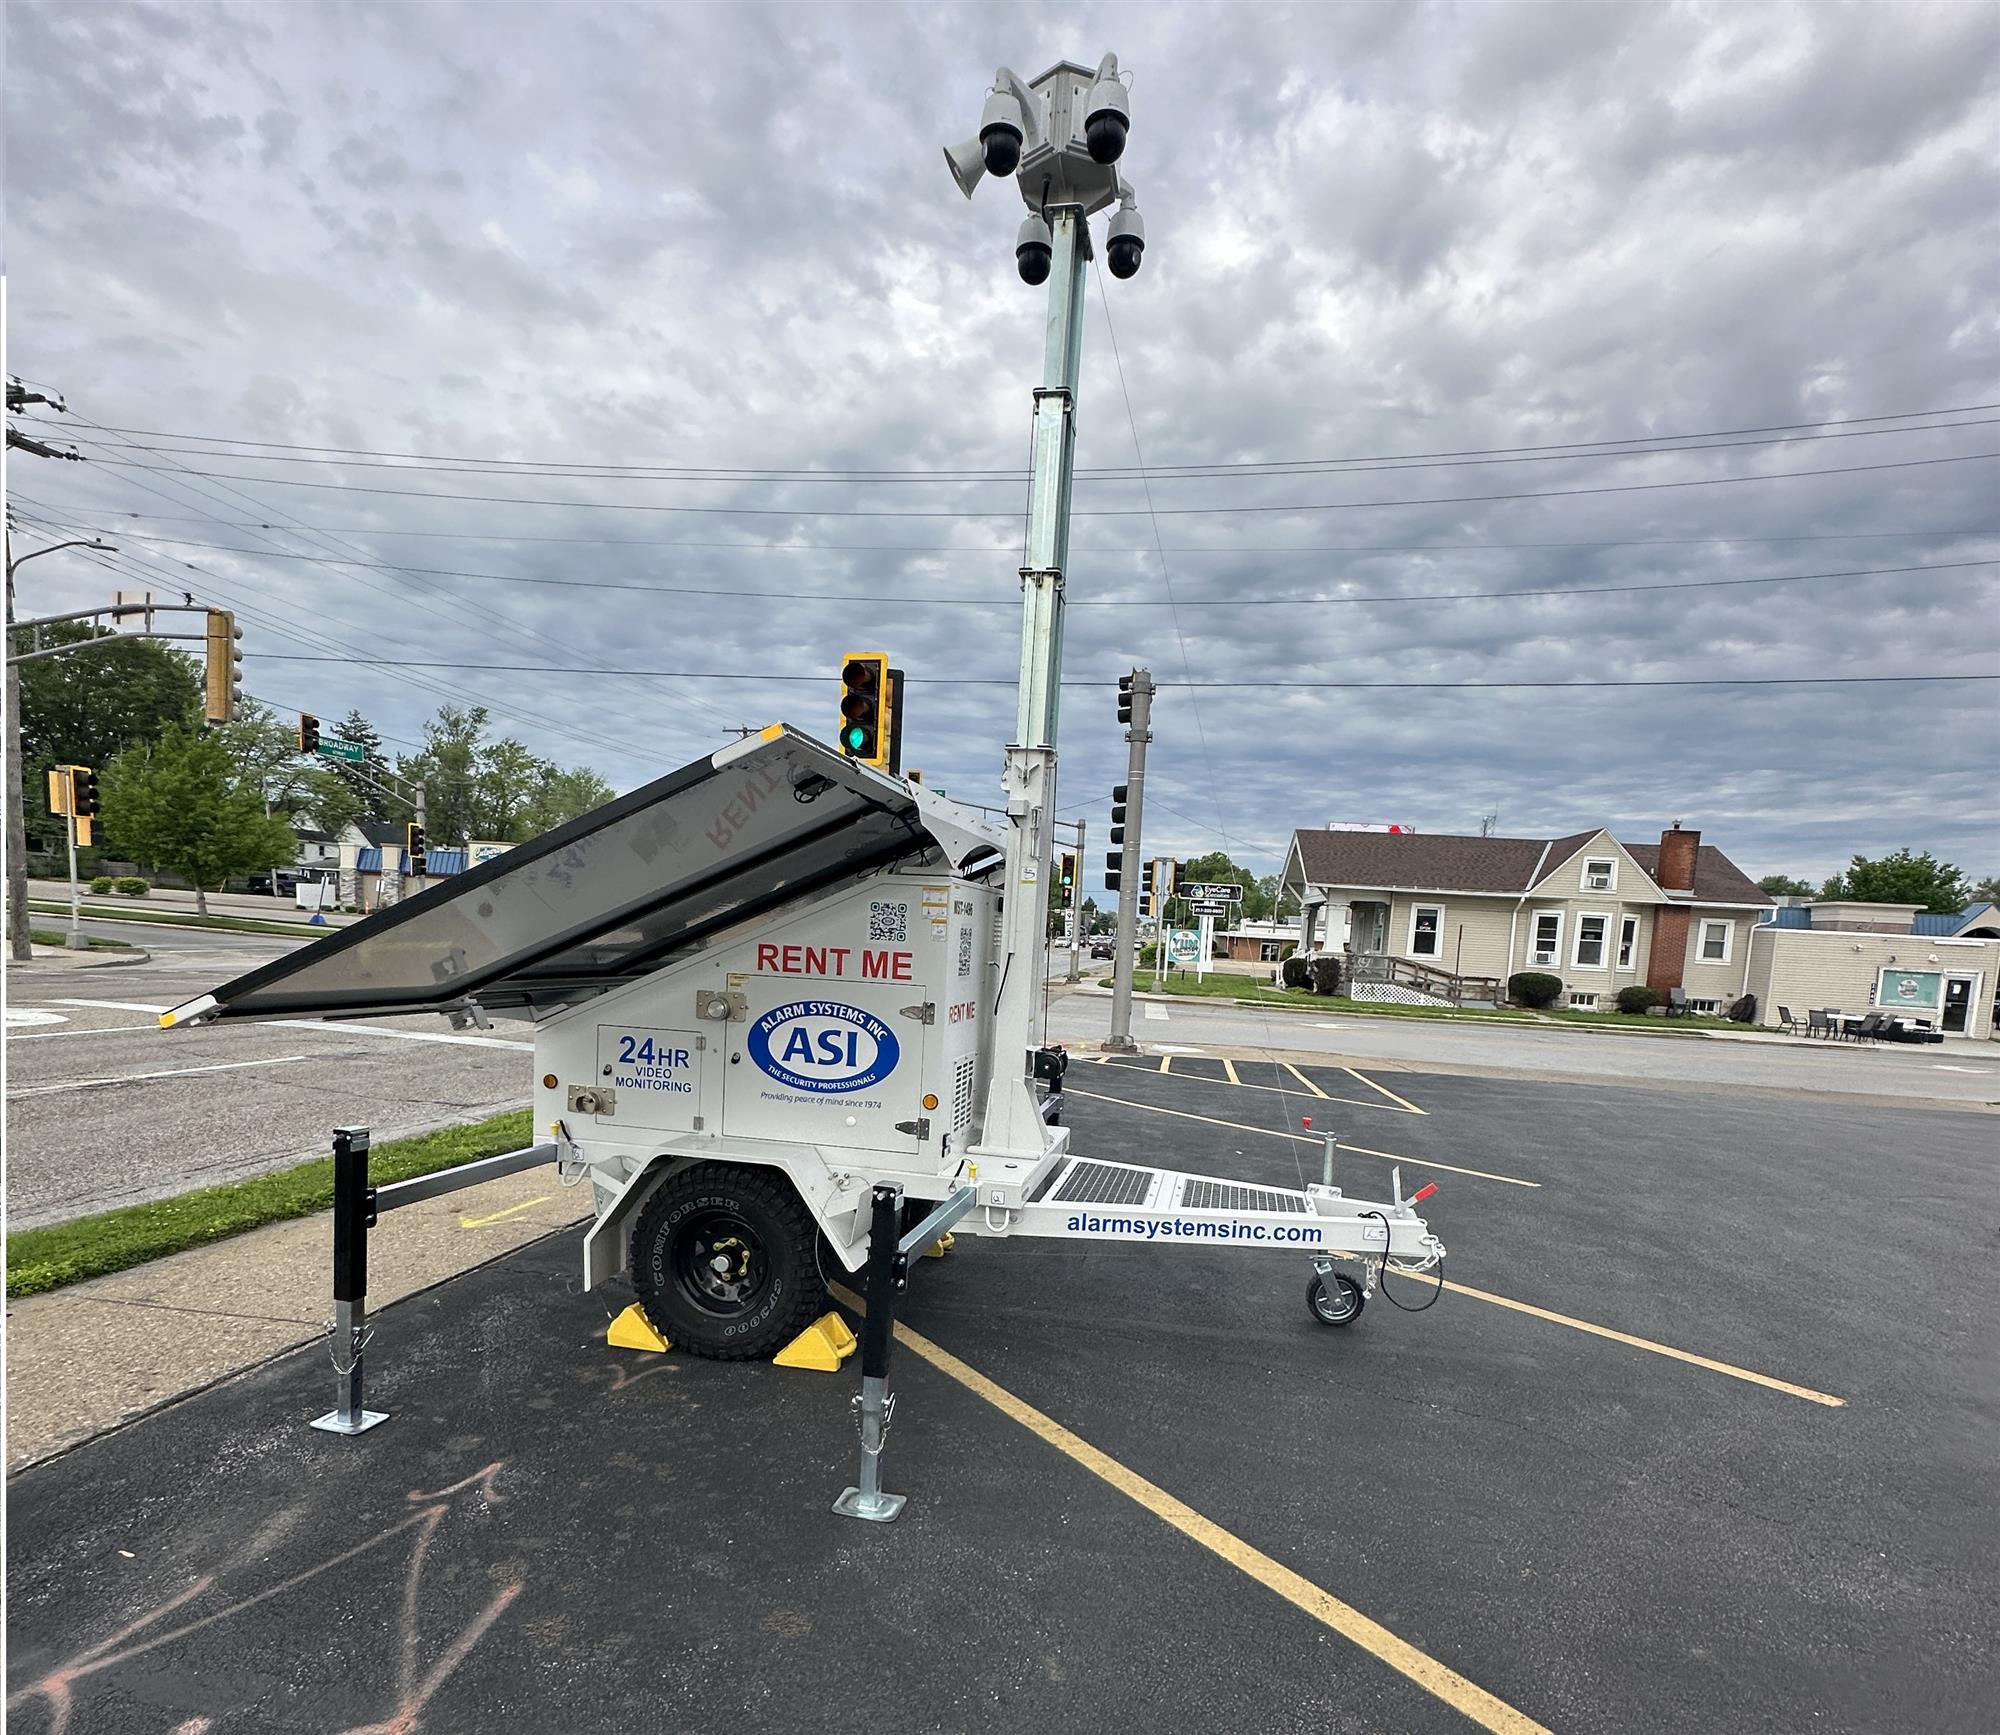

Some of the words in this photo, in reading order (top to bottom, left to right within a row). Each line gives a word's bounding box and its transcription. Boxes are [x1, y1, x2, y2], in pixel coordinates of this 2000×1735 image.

[318, 738, 359, 753] BROADWAY
[757, 943, 851, 976] RENT
[862, 950, 913, 981] ME
[760, 1003, 806, 1033] ALARM
[809, 1002, 867, 1025] SYSTEMS
[866, 1019, 888, 1042] INC
[949, 1003, 966, 1025] RENT
[966, 1001, 976, 1020] ME
[781, 1026, 859, 1068] ASI
[615, 1076, 692, 1093] MONITORING
[635, 1065, 672, 1079] VIDEO
[768, 1064, 781, 1077] THE
[781, 1073, 818, 1089] SECURITY
[818, 1073, 877, 1090] PROFESSIONALS
[760, 1091, 793, 1104] Providing
[794, 1095, 816, 1105] peace
[815, 1096, 825, 1106] of
[825, 1098, 844, 1107] mind
[844, 1098, 864, 1108] since
[864, 1100, 882, 1109] 1974
[1067, 1213, 1322, 1243] alarmsystemsinc.com
[652, 1196, 740, 1287] COMFORSER
